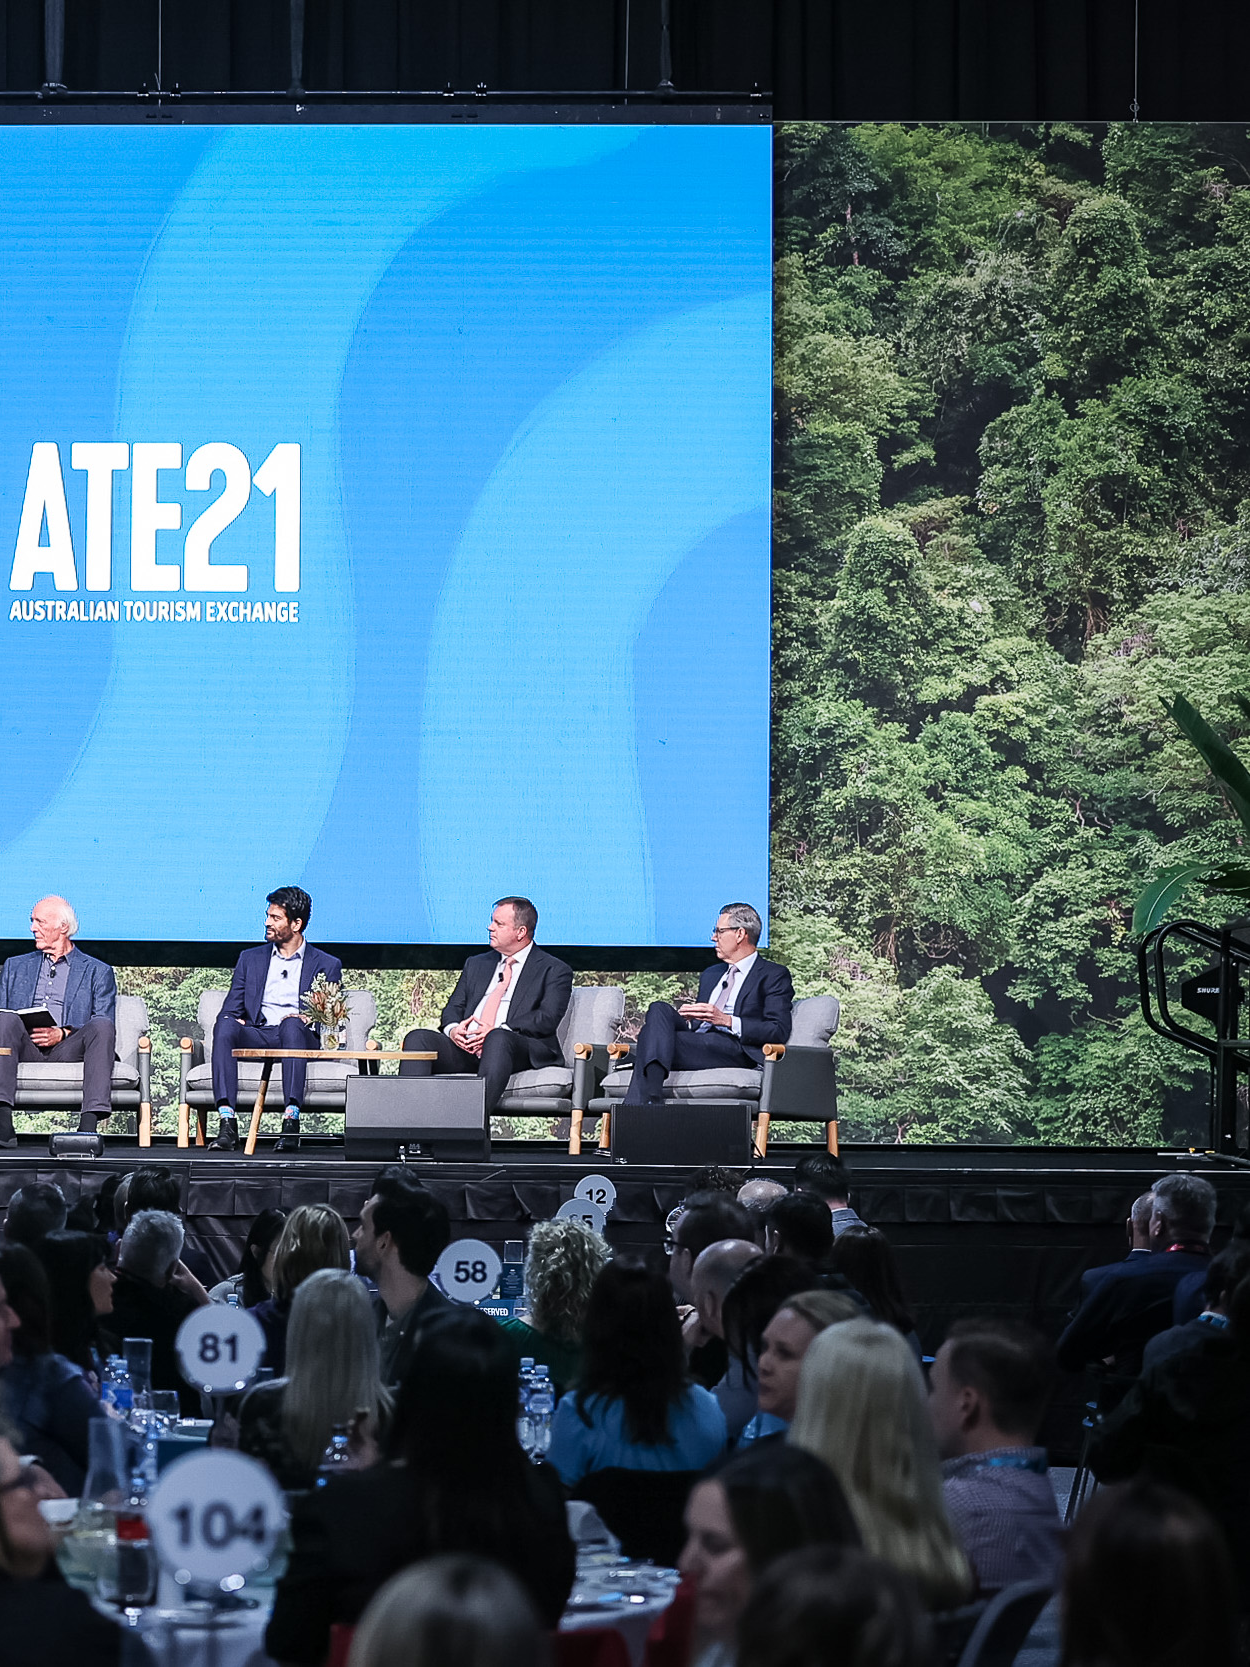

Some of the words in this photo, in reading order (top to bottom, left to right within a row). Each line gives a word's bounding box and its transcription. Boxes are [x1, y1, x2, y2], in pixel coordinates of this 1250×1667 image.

[9, 441, 301, 592] ATE21
[9, 600, 120, 622] AUSTRALIAN
[123, 600, 201, 622] TOURISM
[205, 600, 299, 622] EXCHANGE
[585, 1188, 607, 1205] 12
[453, 1260, 487, 1283] 58
[198, 1331, 240, 1364] 81
[173, 1500, 267, 1550] 104
